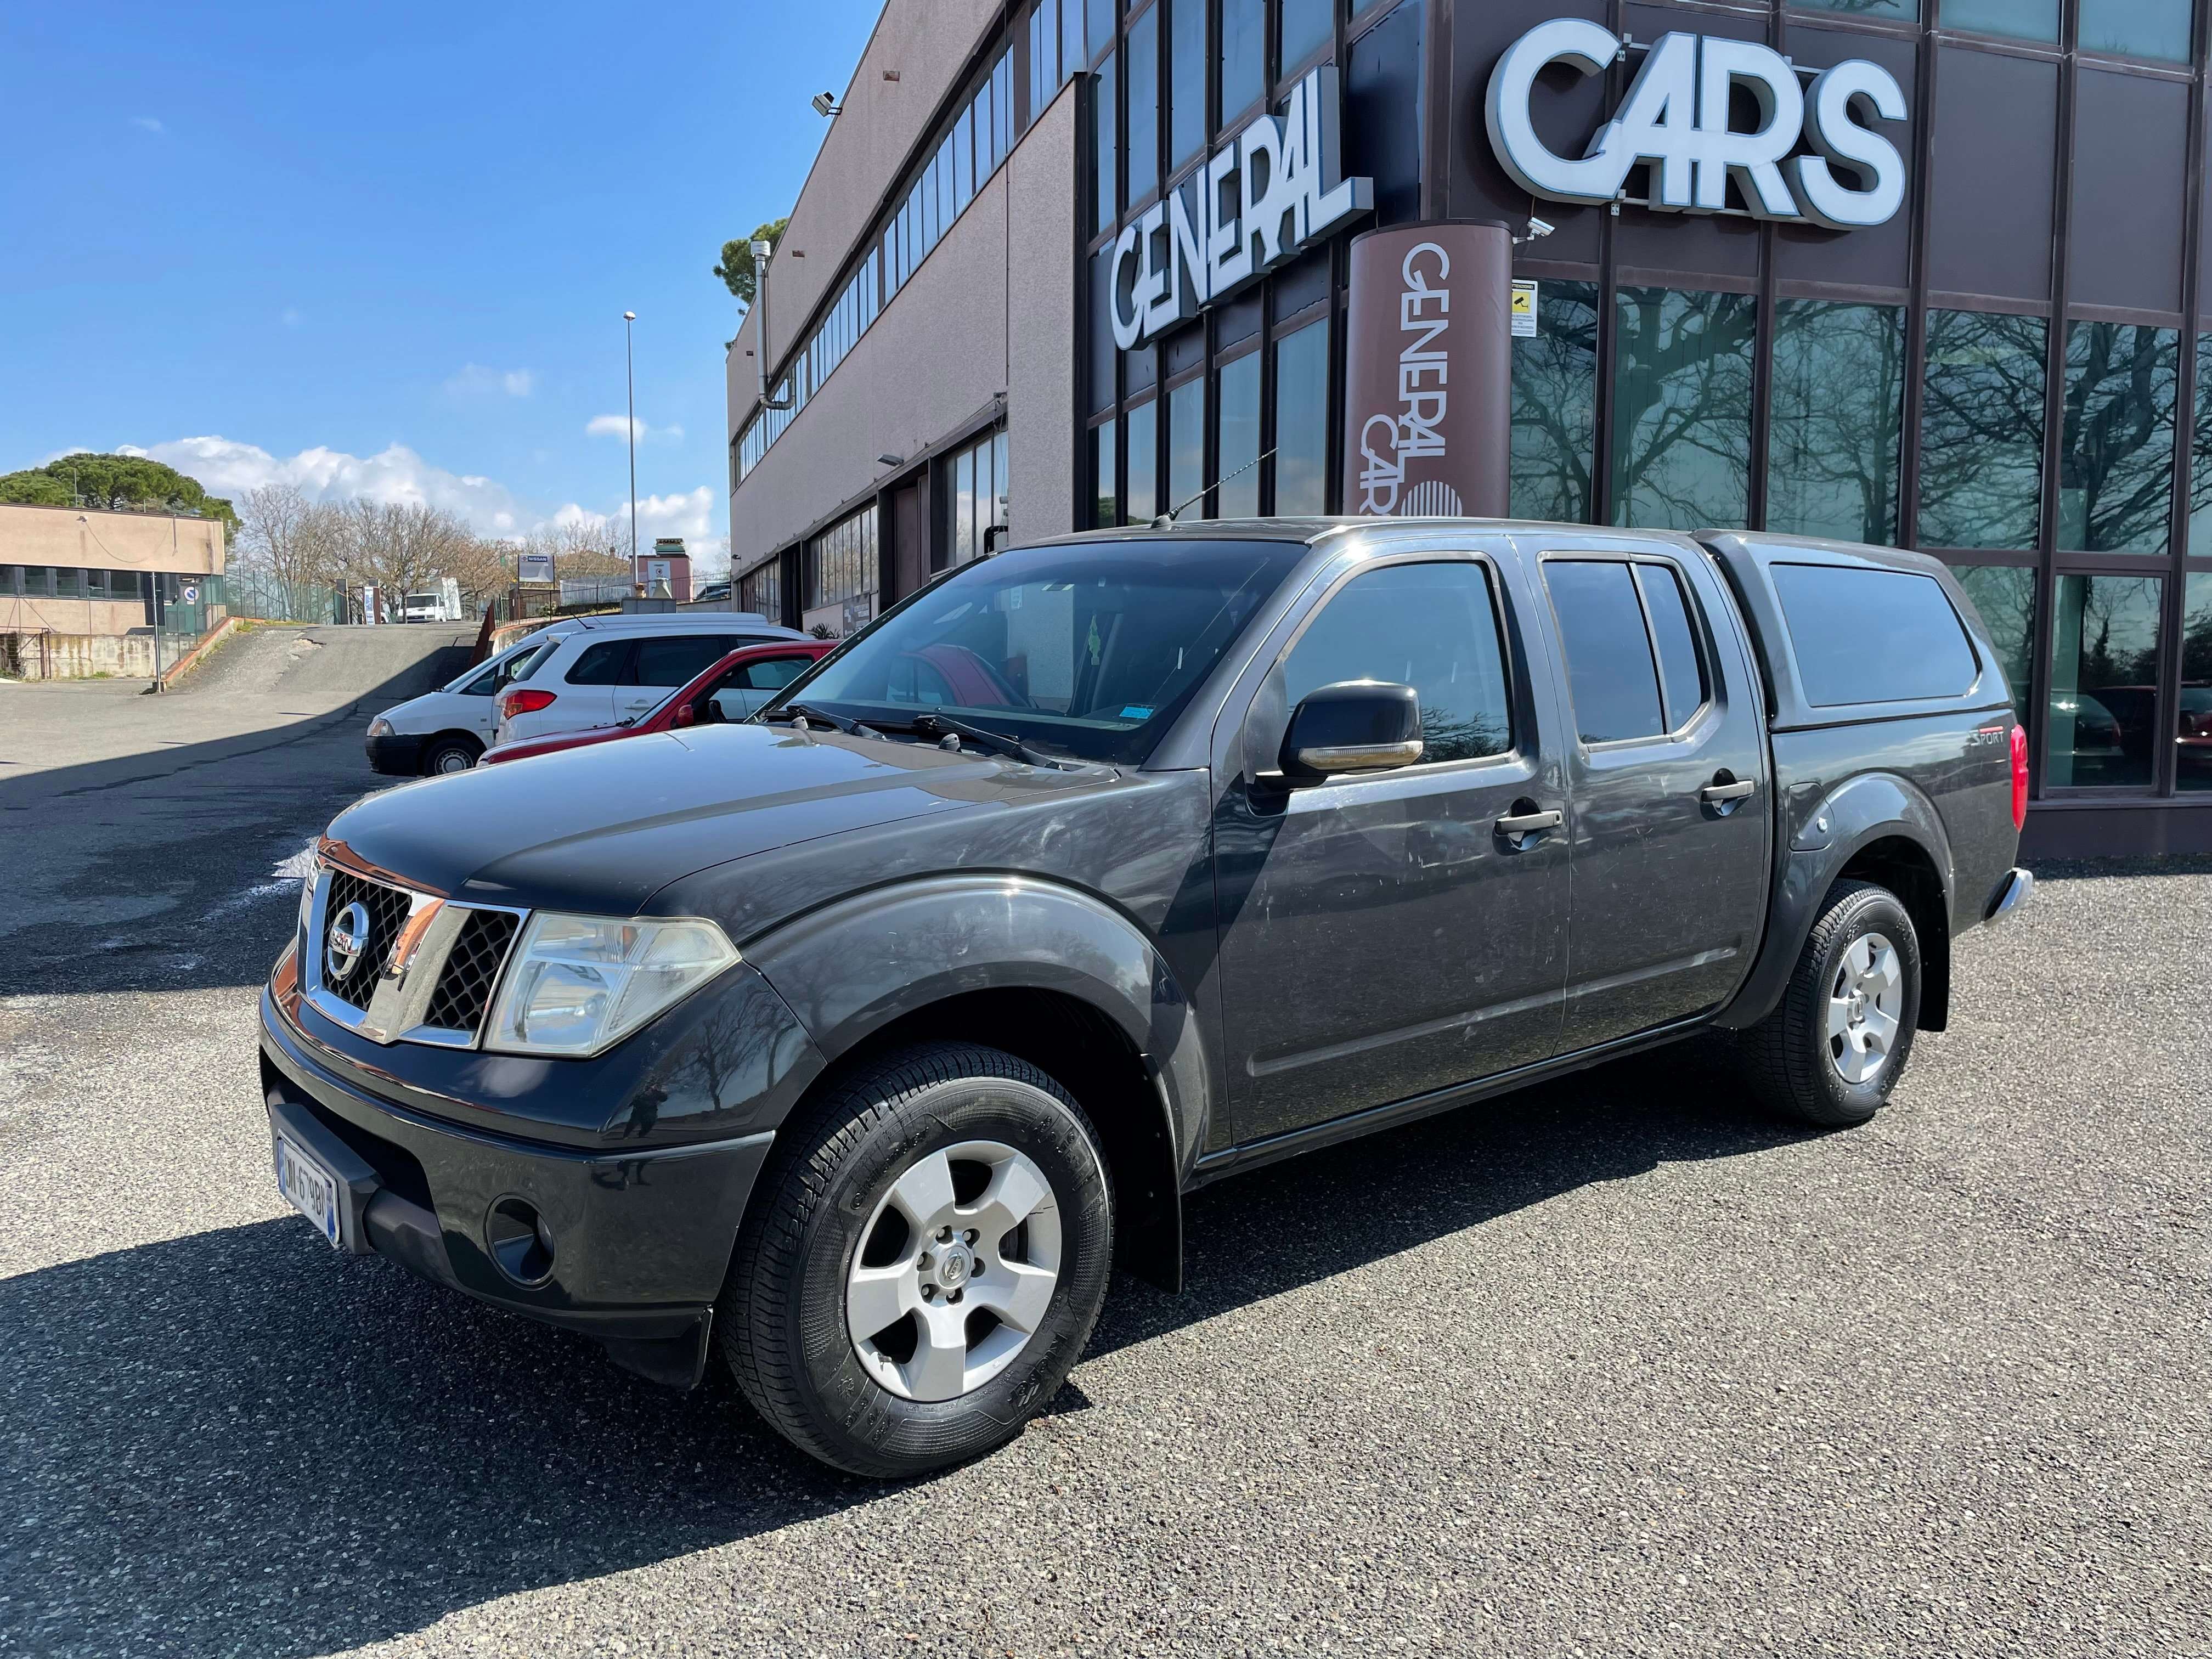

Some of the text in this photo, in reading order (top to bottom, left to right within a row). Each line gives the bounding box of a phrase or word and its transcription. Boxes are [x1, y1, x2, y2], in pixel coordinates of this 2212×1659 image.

[1110, 65, 1372, 351] GENERAL
[1486, 18, 1908, 228] CARS
[1359, 414, 1399, 515] CAR
[1398, 242, 1450, 483] GENERAL
[1966, 729, 2004, 746] SPORT
